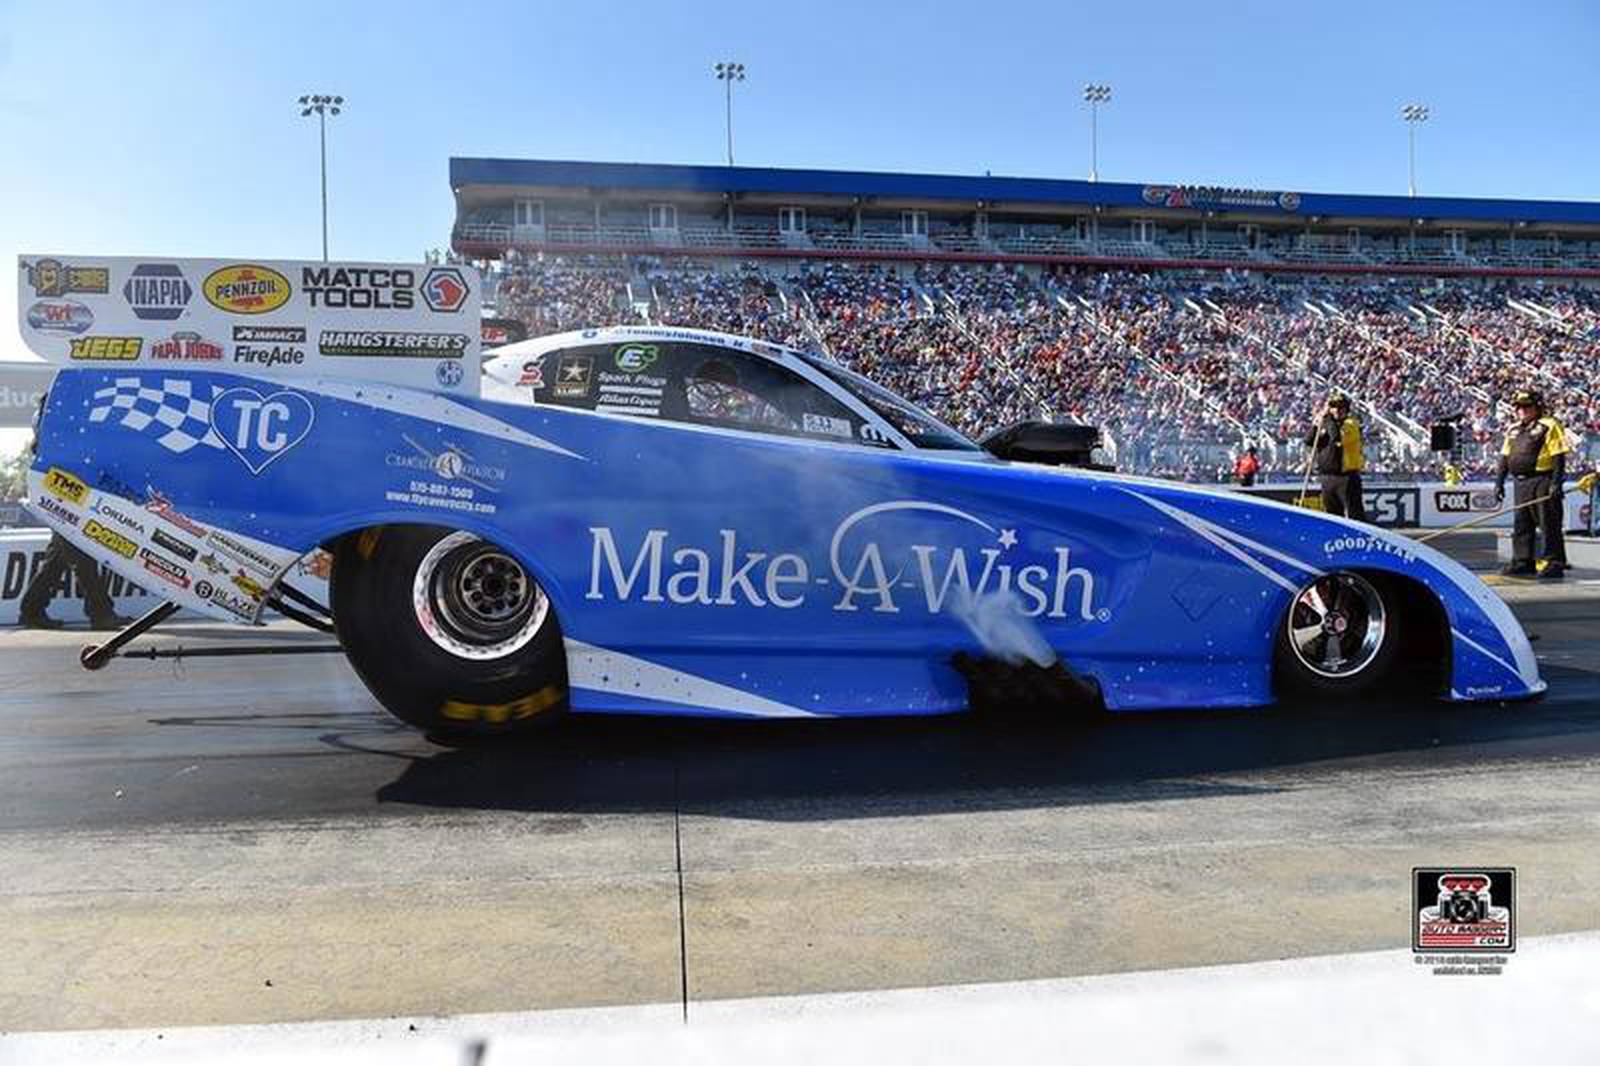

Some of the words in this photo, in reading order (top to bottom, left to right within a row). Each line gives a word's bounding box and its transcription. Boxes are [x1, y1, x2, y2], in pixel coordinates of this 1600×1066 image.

[302, 267, 414, 288] MATCO
[134, 280, 176, 304] NAPA
[216, 280, 277, 299] PENNZOIL
[302, 288, 414, 309] TOOLS
[79, 337, 140, 358] JEGS
[151, 343, 182, 359] PAPA
[320, 333, 465, 349] HANGSTERFER'S
[234, 346, 305, 367] FireAde
[232, 400, 290, 452] TC
[50, 470, 85, 497] TMS
[1438, 493, 1469, 509] FOX
[101, 504, 145, 534] OKUMA
[1324, 536, 1417, 564] GOODYEAR
[585, 522, 1096, 621] Make-A-Wish
